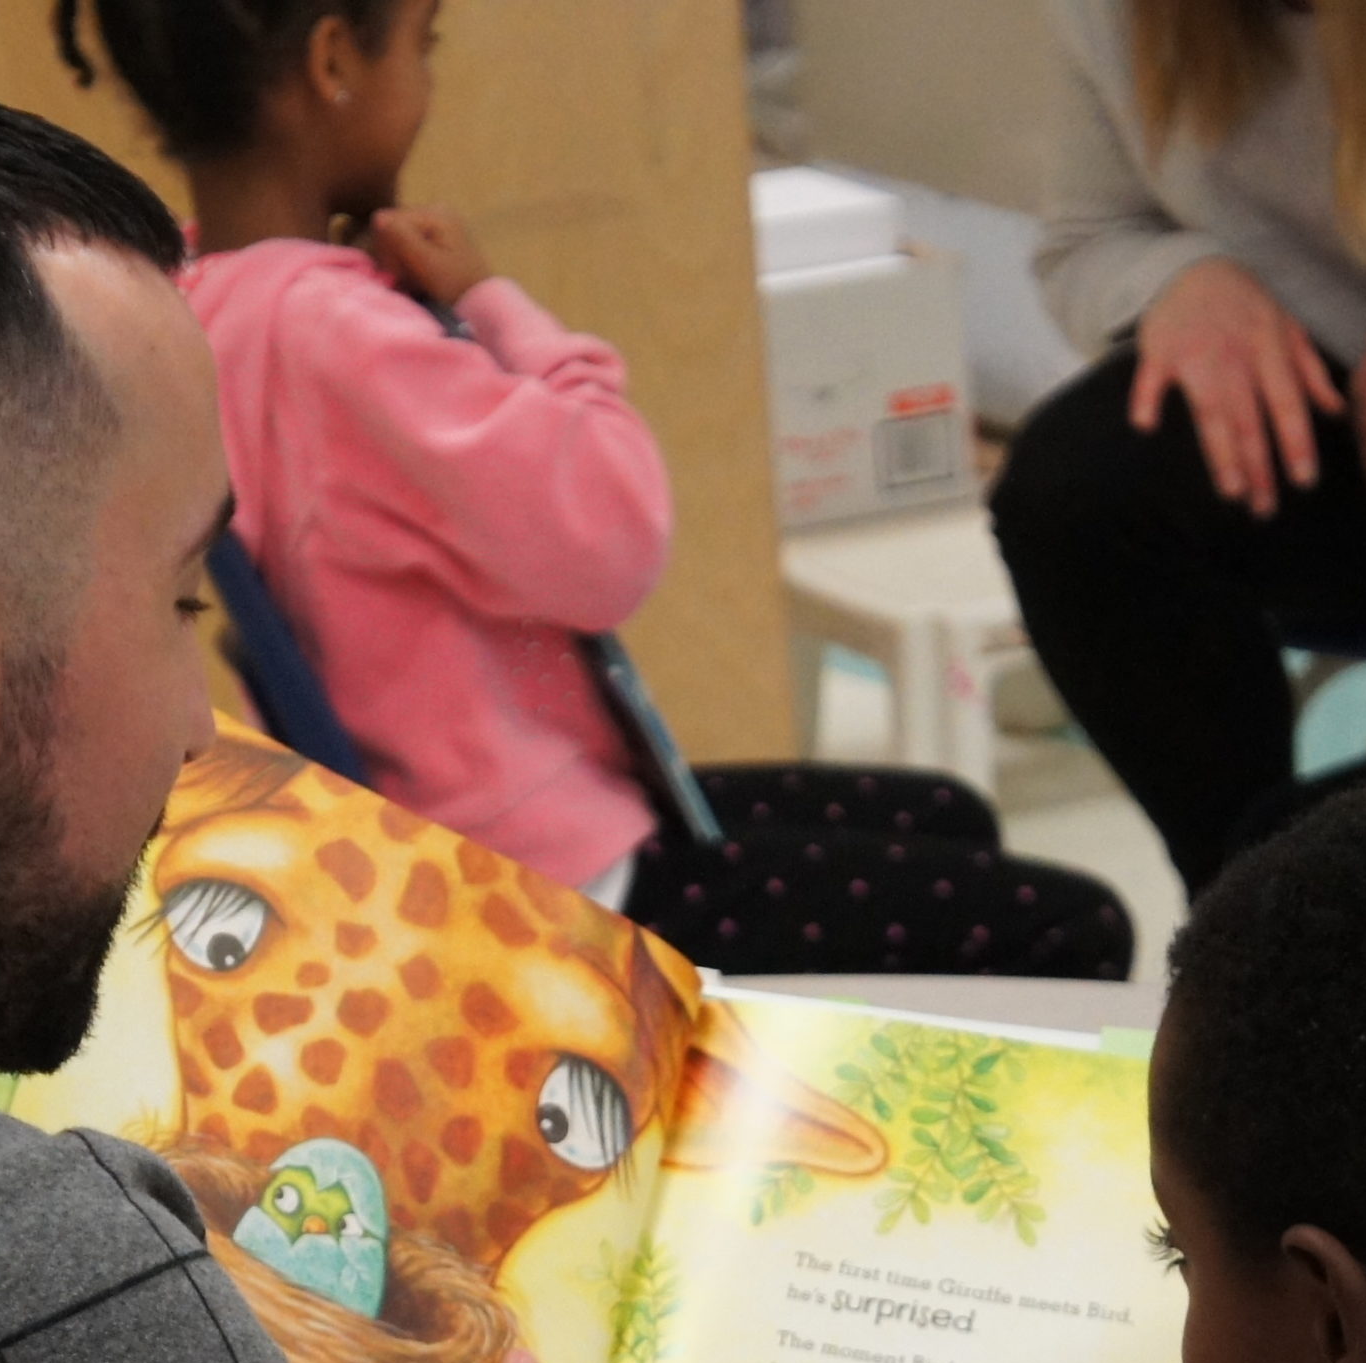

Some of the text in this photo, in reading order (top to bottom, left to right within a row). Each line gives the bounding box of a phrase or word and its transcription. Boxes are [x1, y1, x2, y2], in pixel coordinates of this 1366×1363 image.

[787, 1283, 827, 1304] he's
[795, 1250, 833, 1272] The
[838, 1258, 881, 1282] first
[886, 1269, 933, 1291] time
[937, 1277, 1013, 1304] Giraffe
[1018, 1295, 1081, 1316] meets
[777, 1329, 815, 1351] The
